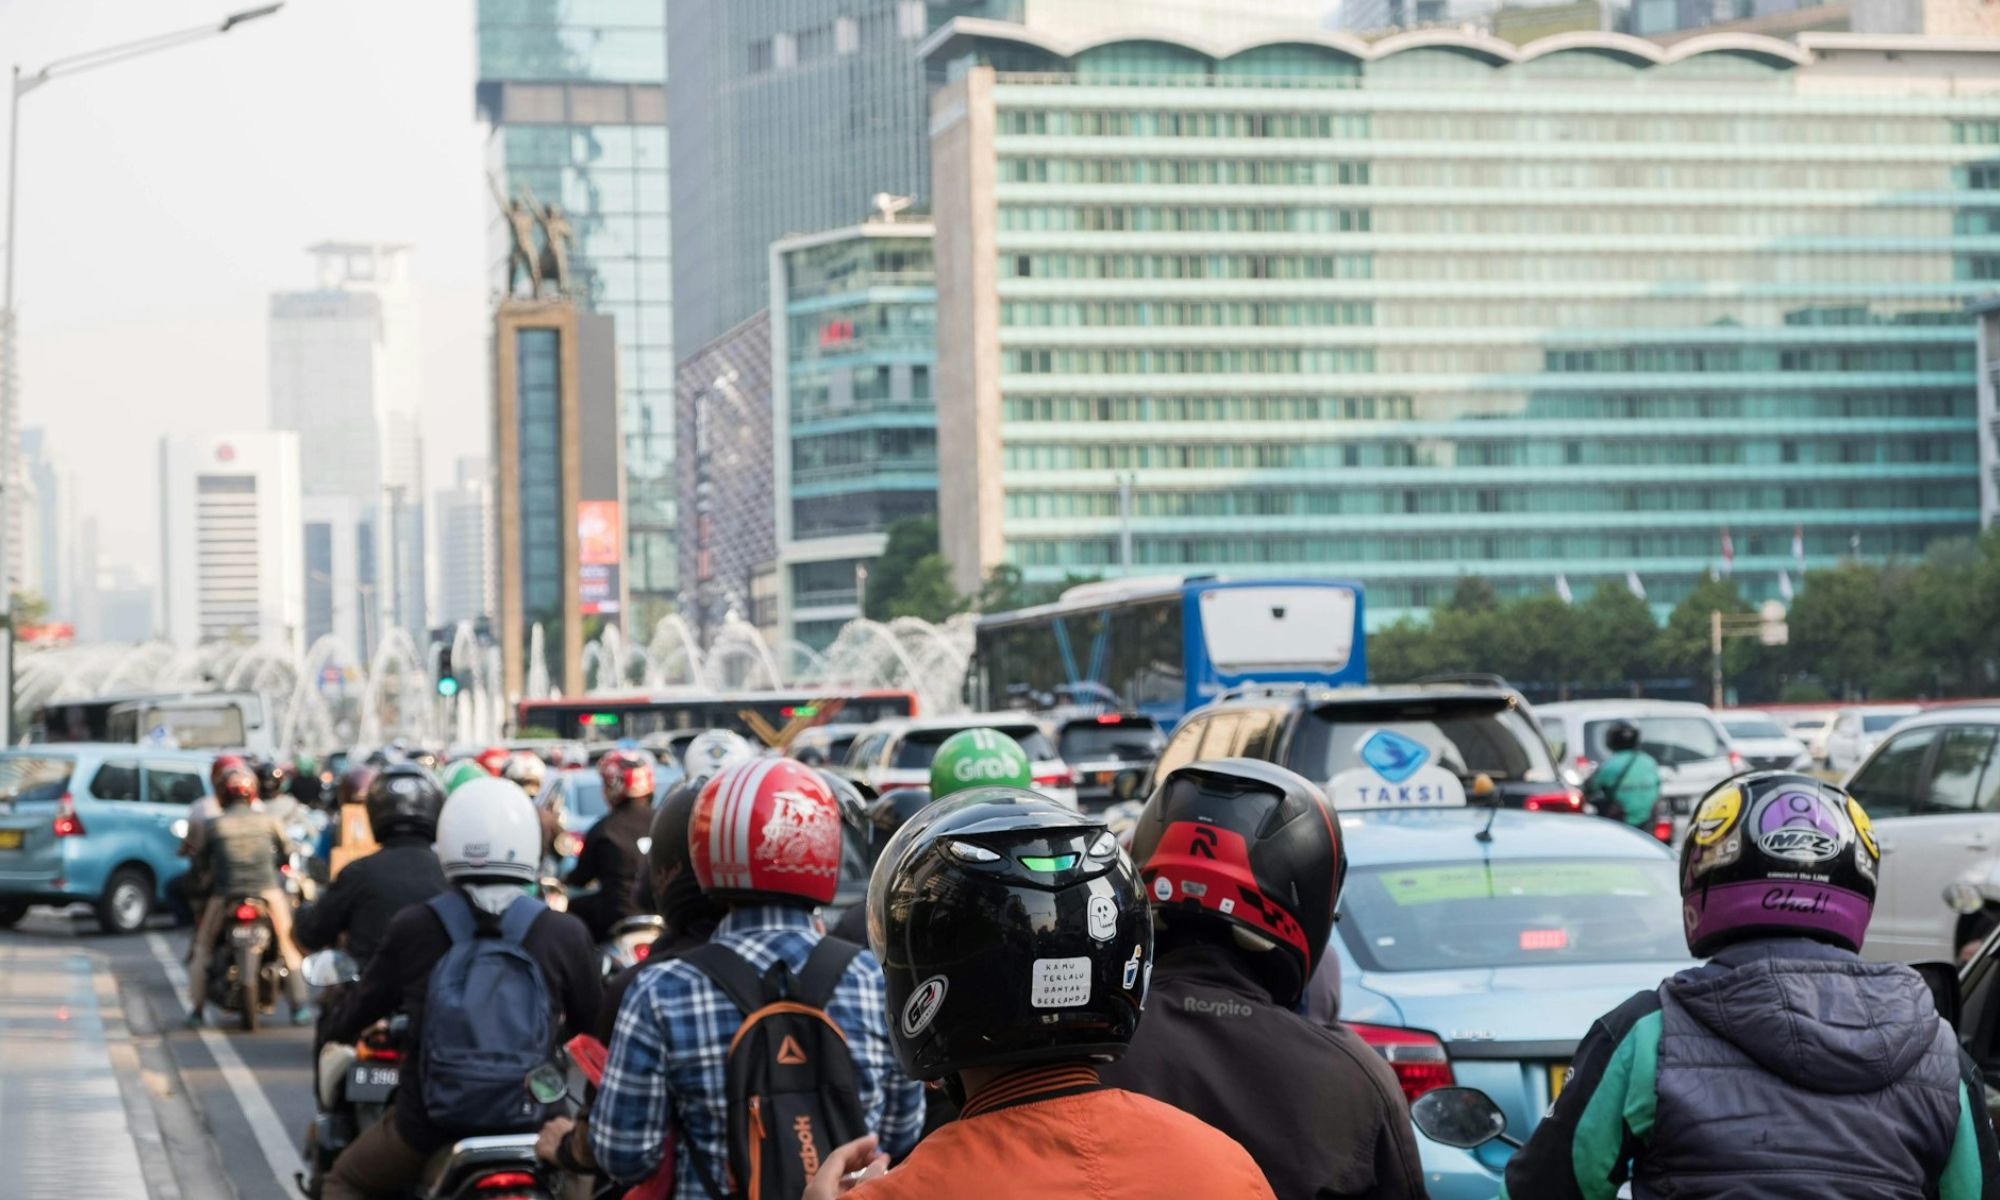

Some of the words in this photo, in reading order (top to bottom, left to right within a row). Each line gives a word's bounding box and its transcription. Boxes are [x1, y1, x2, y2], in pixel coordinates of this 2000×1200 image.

[954, 752, 1020, 780] Grab
[1359, 786, 1443, 802] TAKSI
[1769, 833, 1833, 850] MAZ
[1799, 872, 1812, 880] the
[1762, 888, 1830, 913] Chat!
[1043, 973, 1084, 982] TERLALU
[1183, 996, 1252, 1017] Respiro
